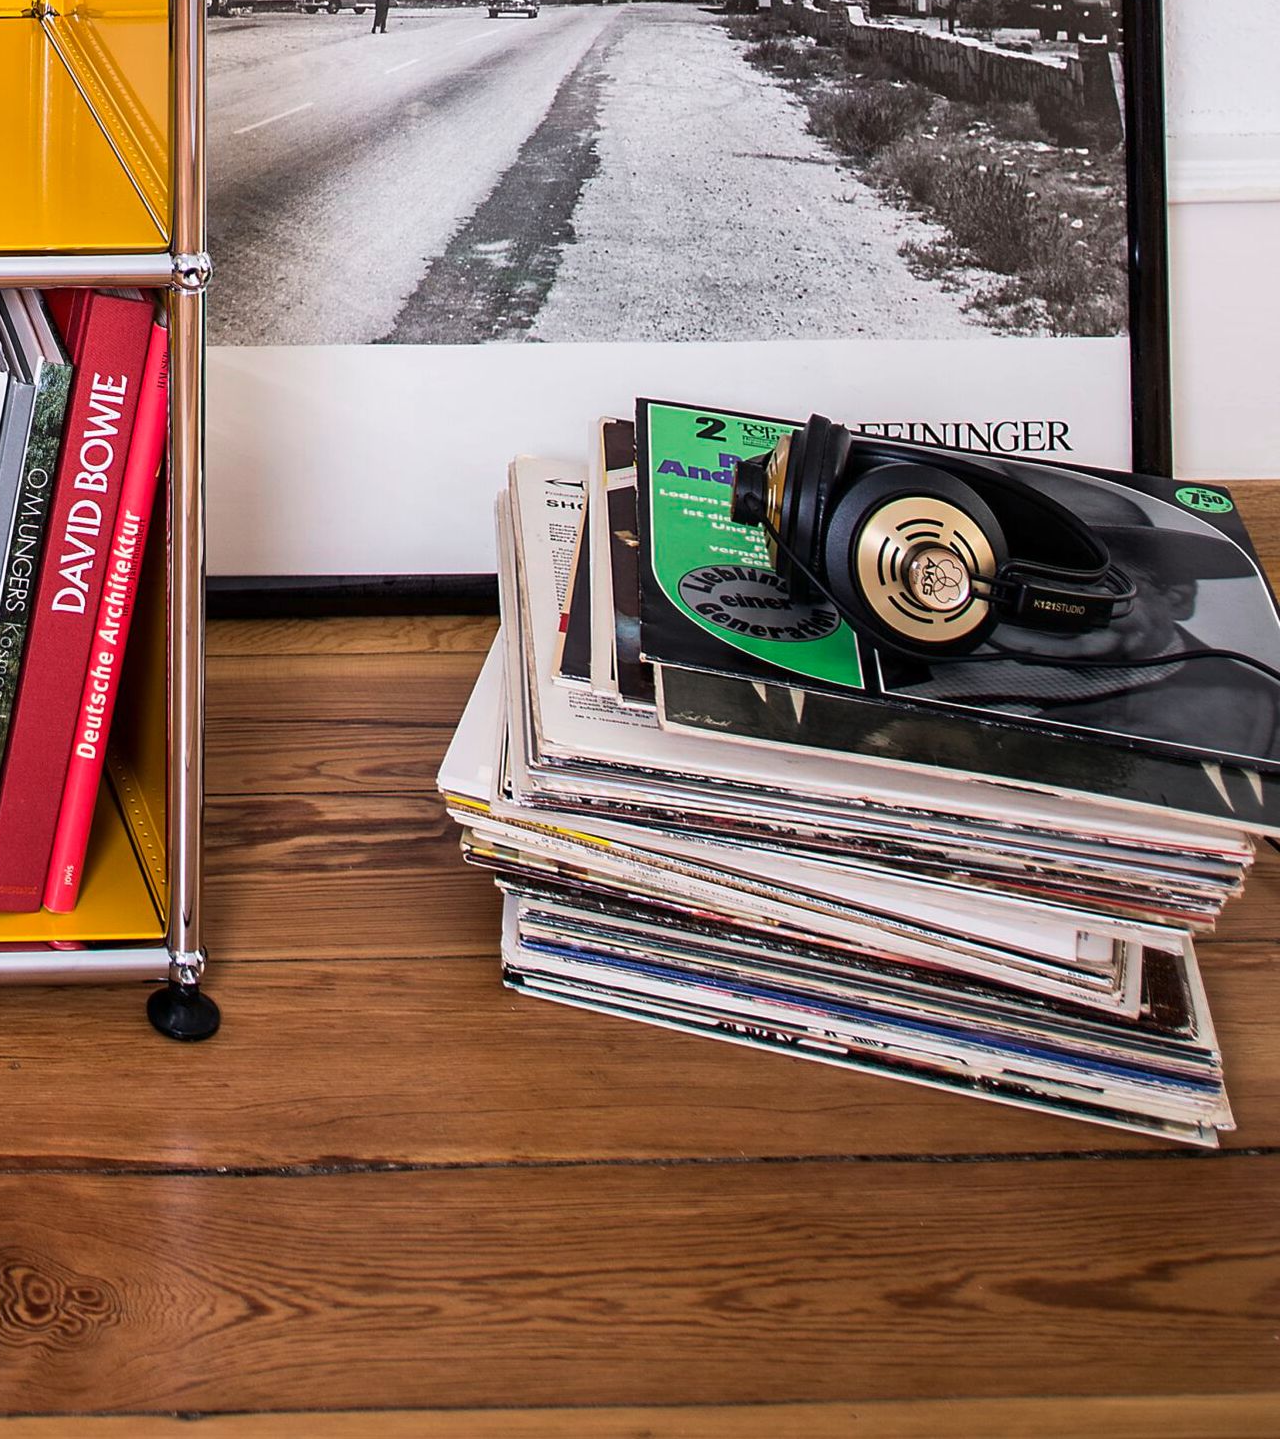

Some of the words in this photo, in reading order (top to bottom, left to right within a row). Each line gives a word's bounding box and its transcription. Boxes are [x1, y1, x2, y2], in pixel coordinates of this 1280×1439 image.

[73, 372, 128, 494] BOWIE
[695, 416, 727, 443] 2
[51, 499, 103, 615] DAVID
[94, 509, 141, 645] Architektur
[922, 557, 937, 596] AKG
[695, 602, 838, 640] Generation
[76, 652, 115, 760] Deutsche
